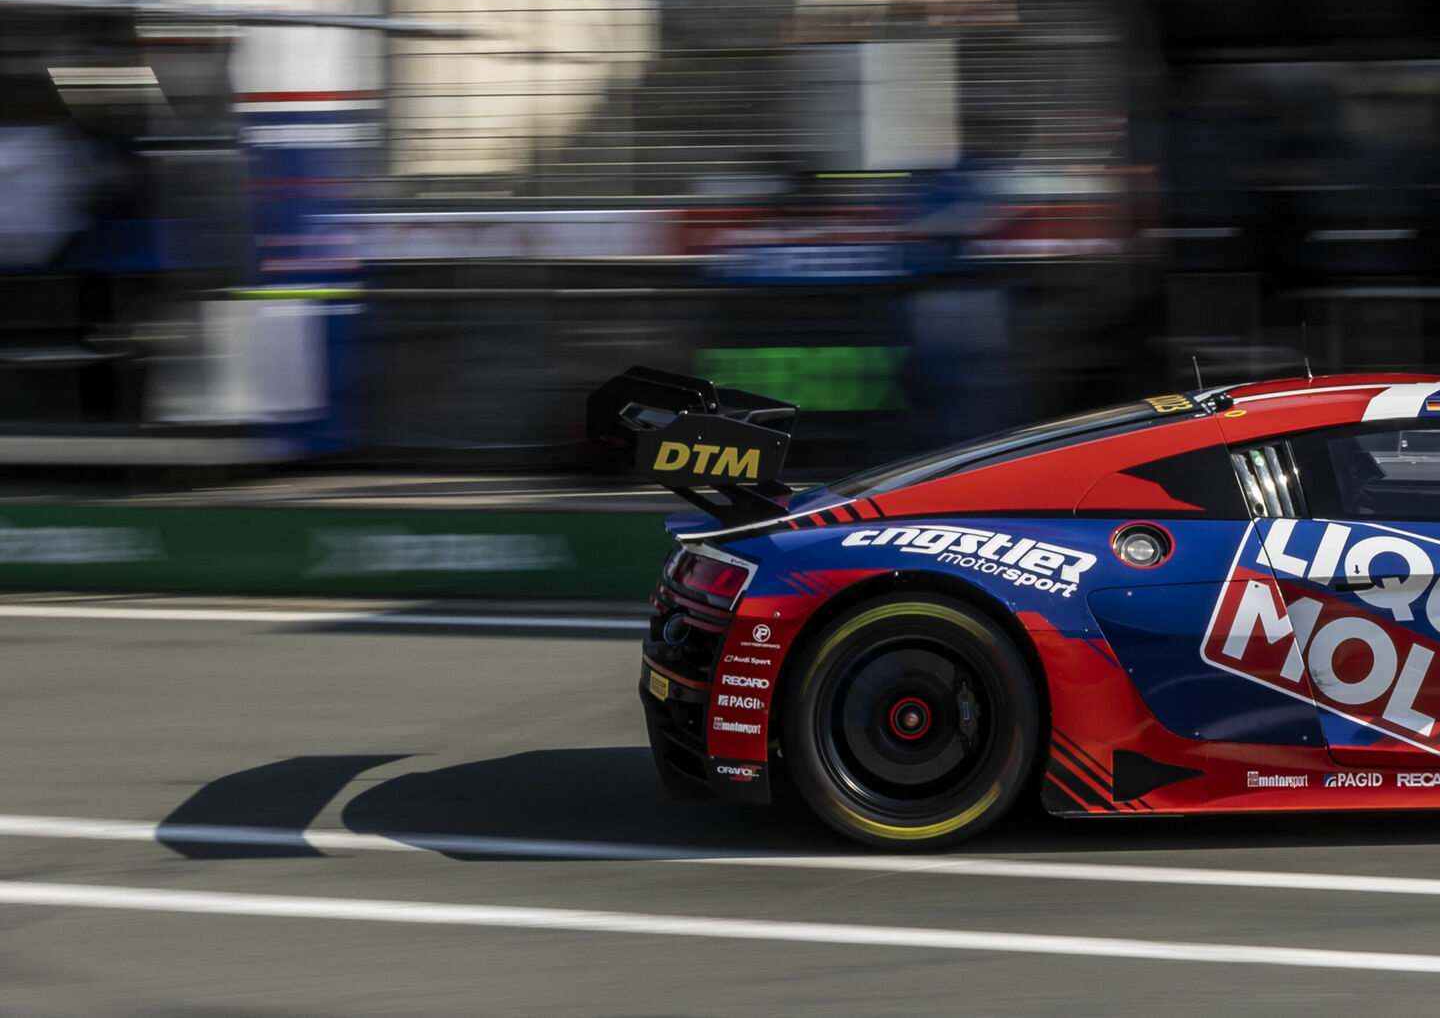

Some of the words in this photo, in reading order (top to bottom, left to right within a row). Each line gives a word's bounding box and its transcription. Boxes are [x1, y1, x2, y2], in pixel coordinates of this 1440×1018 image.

[653, 441, 760, 479] DTM
[937, 551, 1077, 598] motorsport
[751, 657, 771, 666] Sport
[722, 675, 770, 689] RECARO
[717, 766, 753, 777] ORAFOL
[1258, 774, 1309, 789] motorsport
[1338, 773, 1383, 787] PAGID
